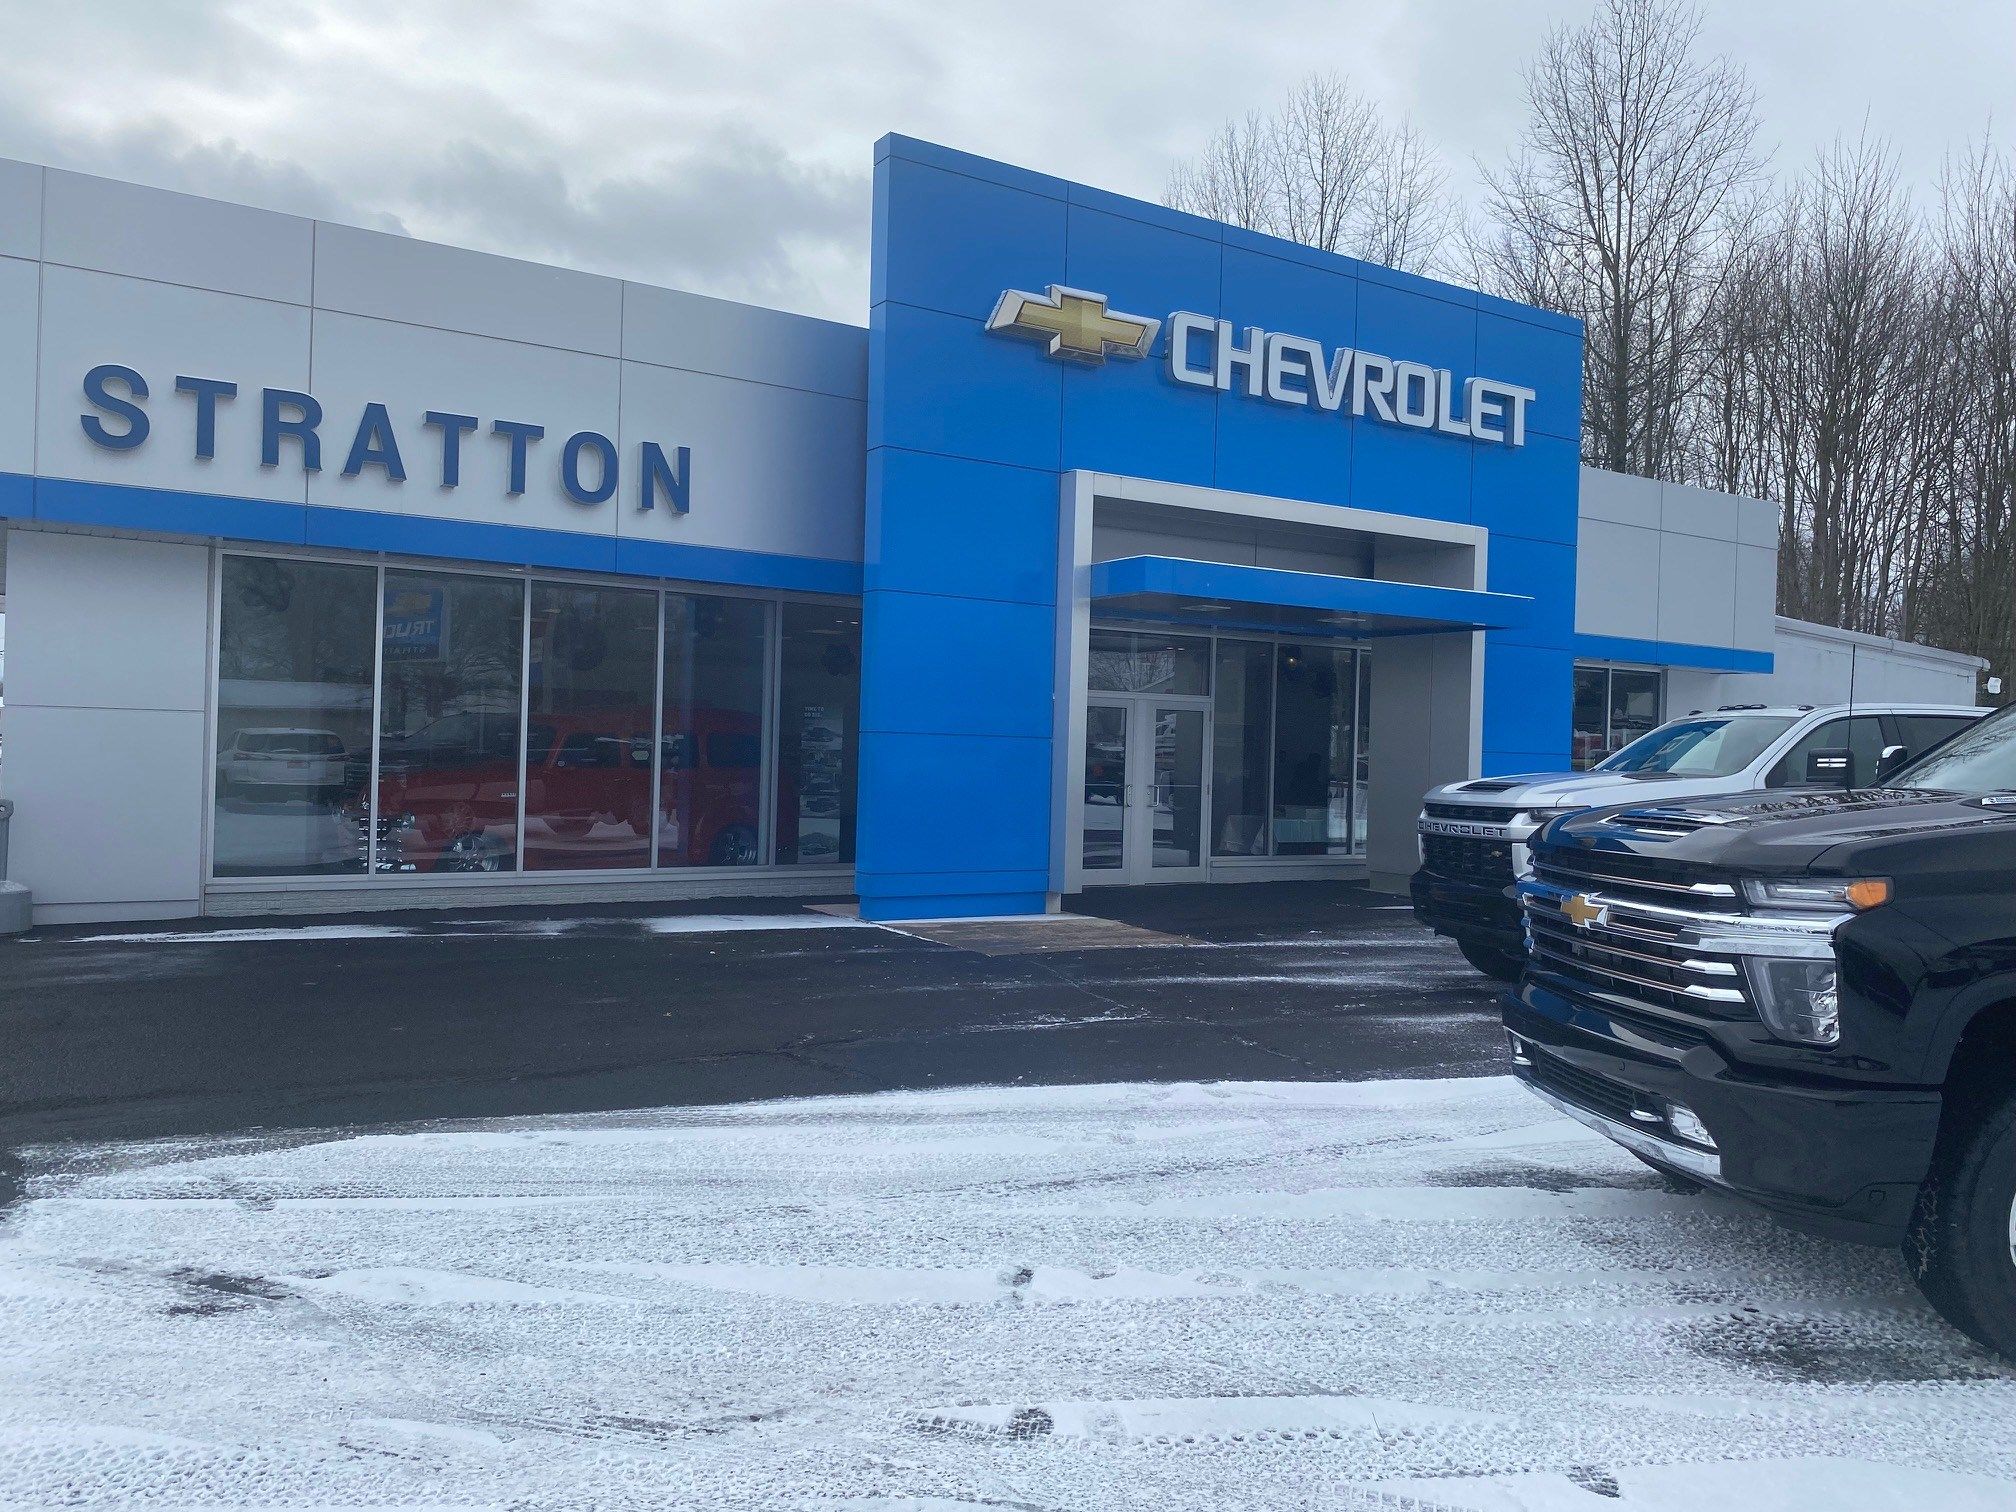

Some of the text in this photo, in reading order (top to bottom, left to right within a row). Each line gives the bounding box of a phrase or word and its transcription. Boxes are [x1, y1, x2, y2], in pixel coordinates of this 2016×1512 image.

[80, 363, 691, 515] STRATTON
[1166, 311, 1536, 447] CHEVROLET
[1417, 821, 1507, 837] CHEVROLET
